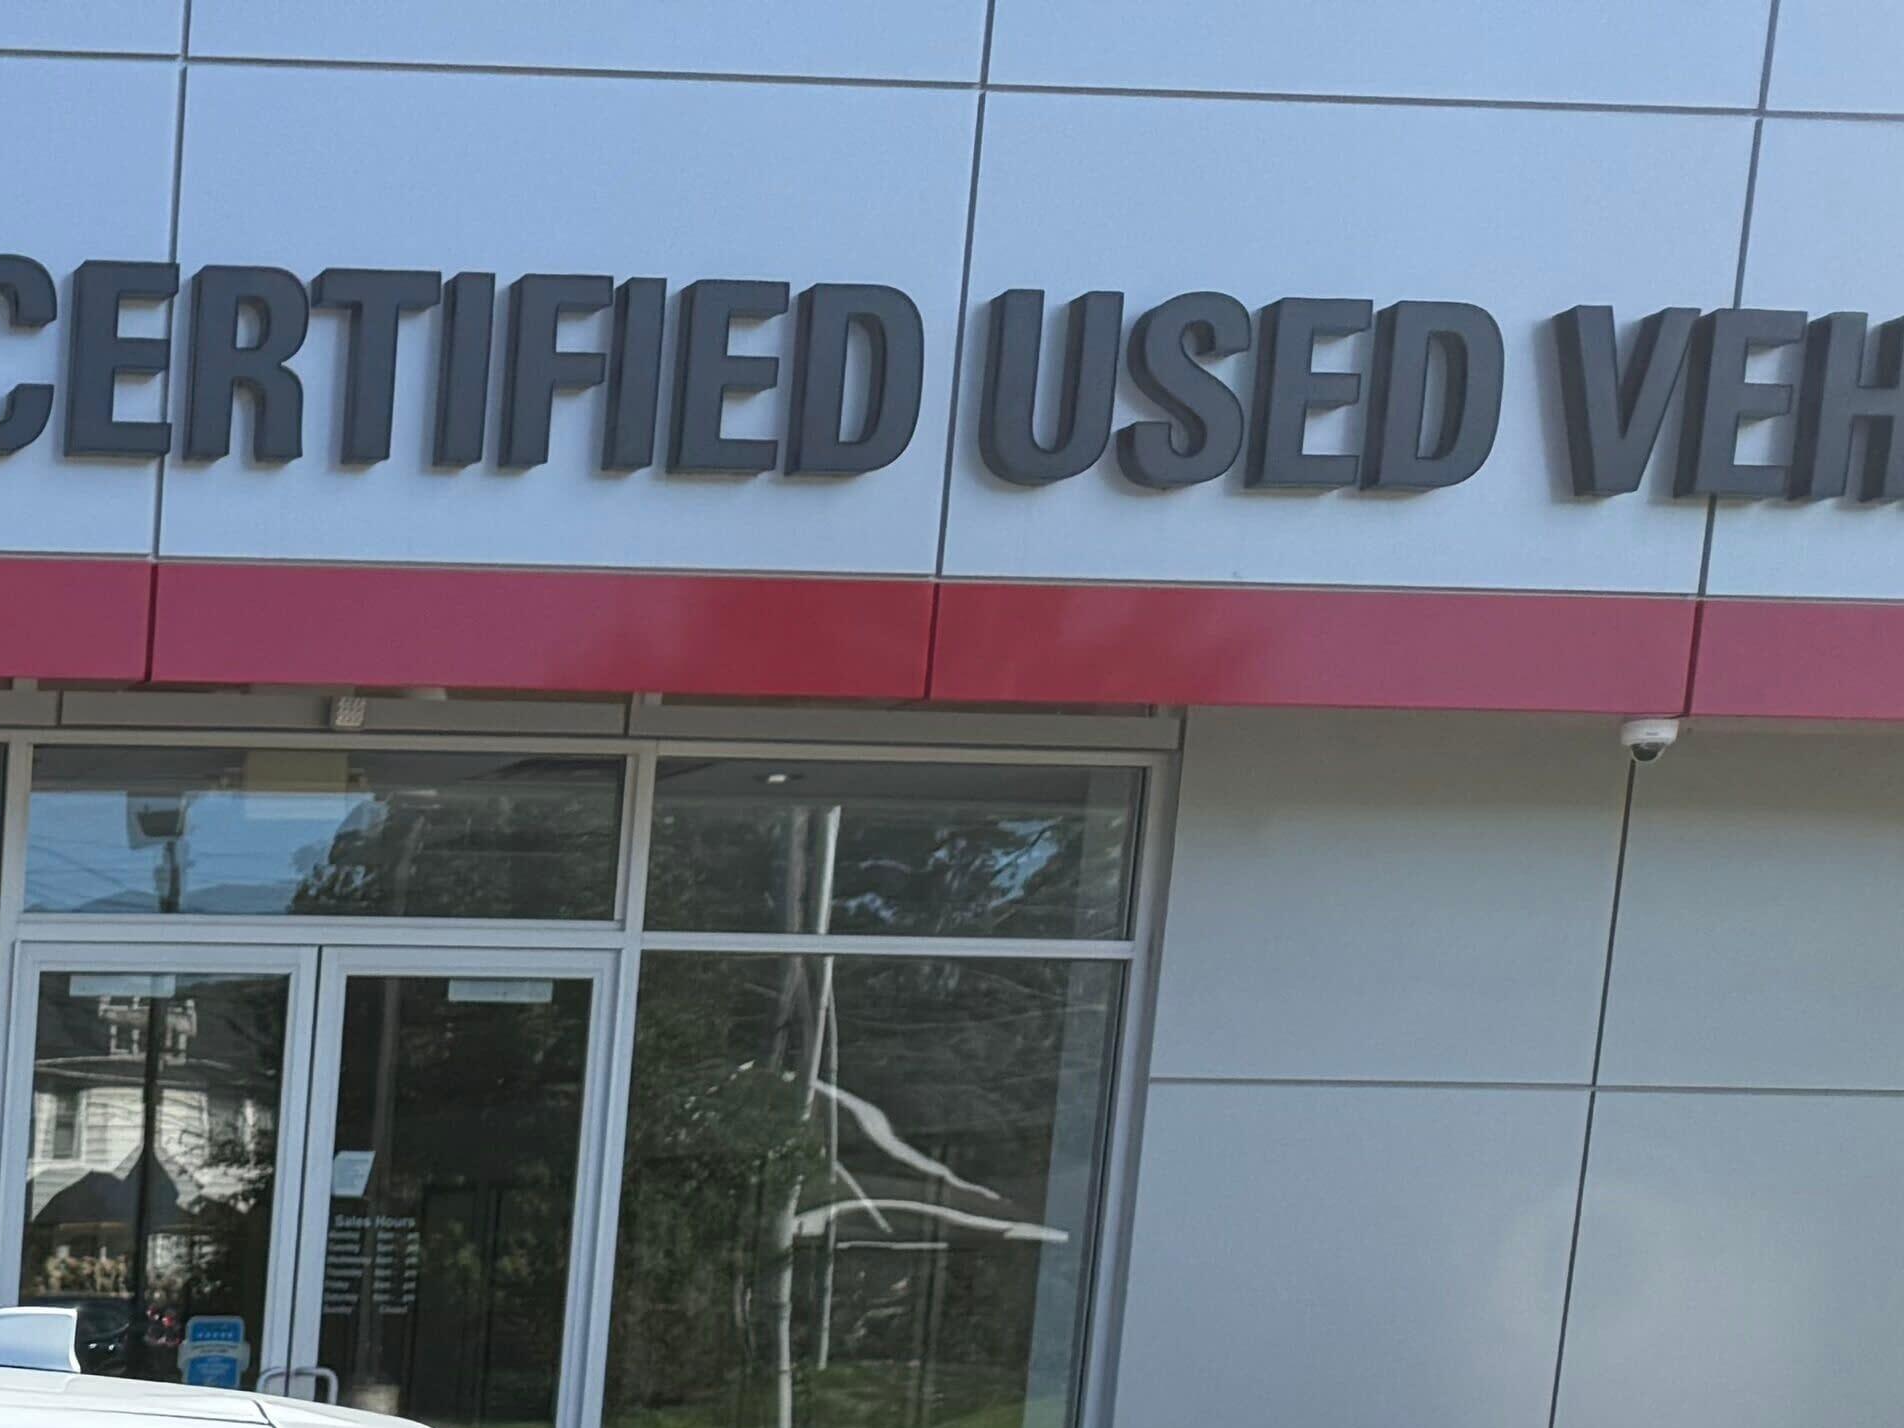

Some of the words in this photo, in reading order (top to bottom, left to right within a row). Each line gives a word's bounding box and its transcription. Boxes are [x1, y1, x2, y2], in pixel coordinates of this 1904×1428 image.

[979, 290, 1505, 490] USED
[335, 1215, 371, 1228] Sales
[375, 1215, 415, 1228] Hours
